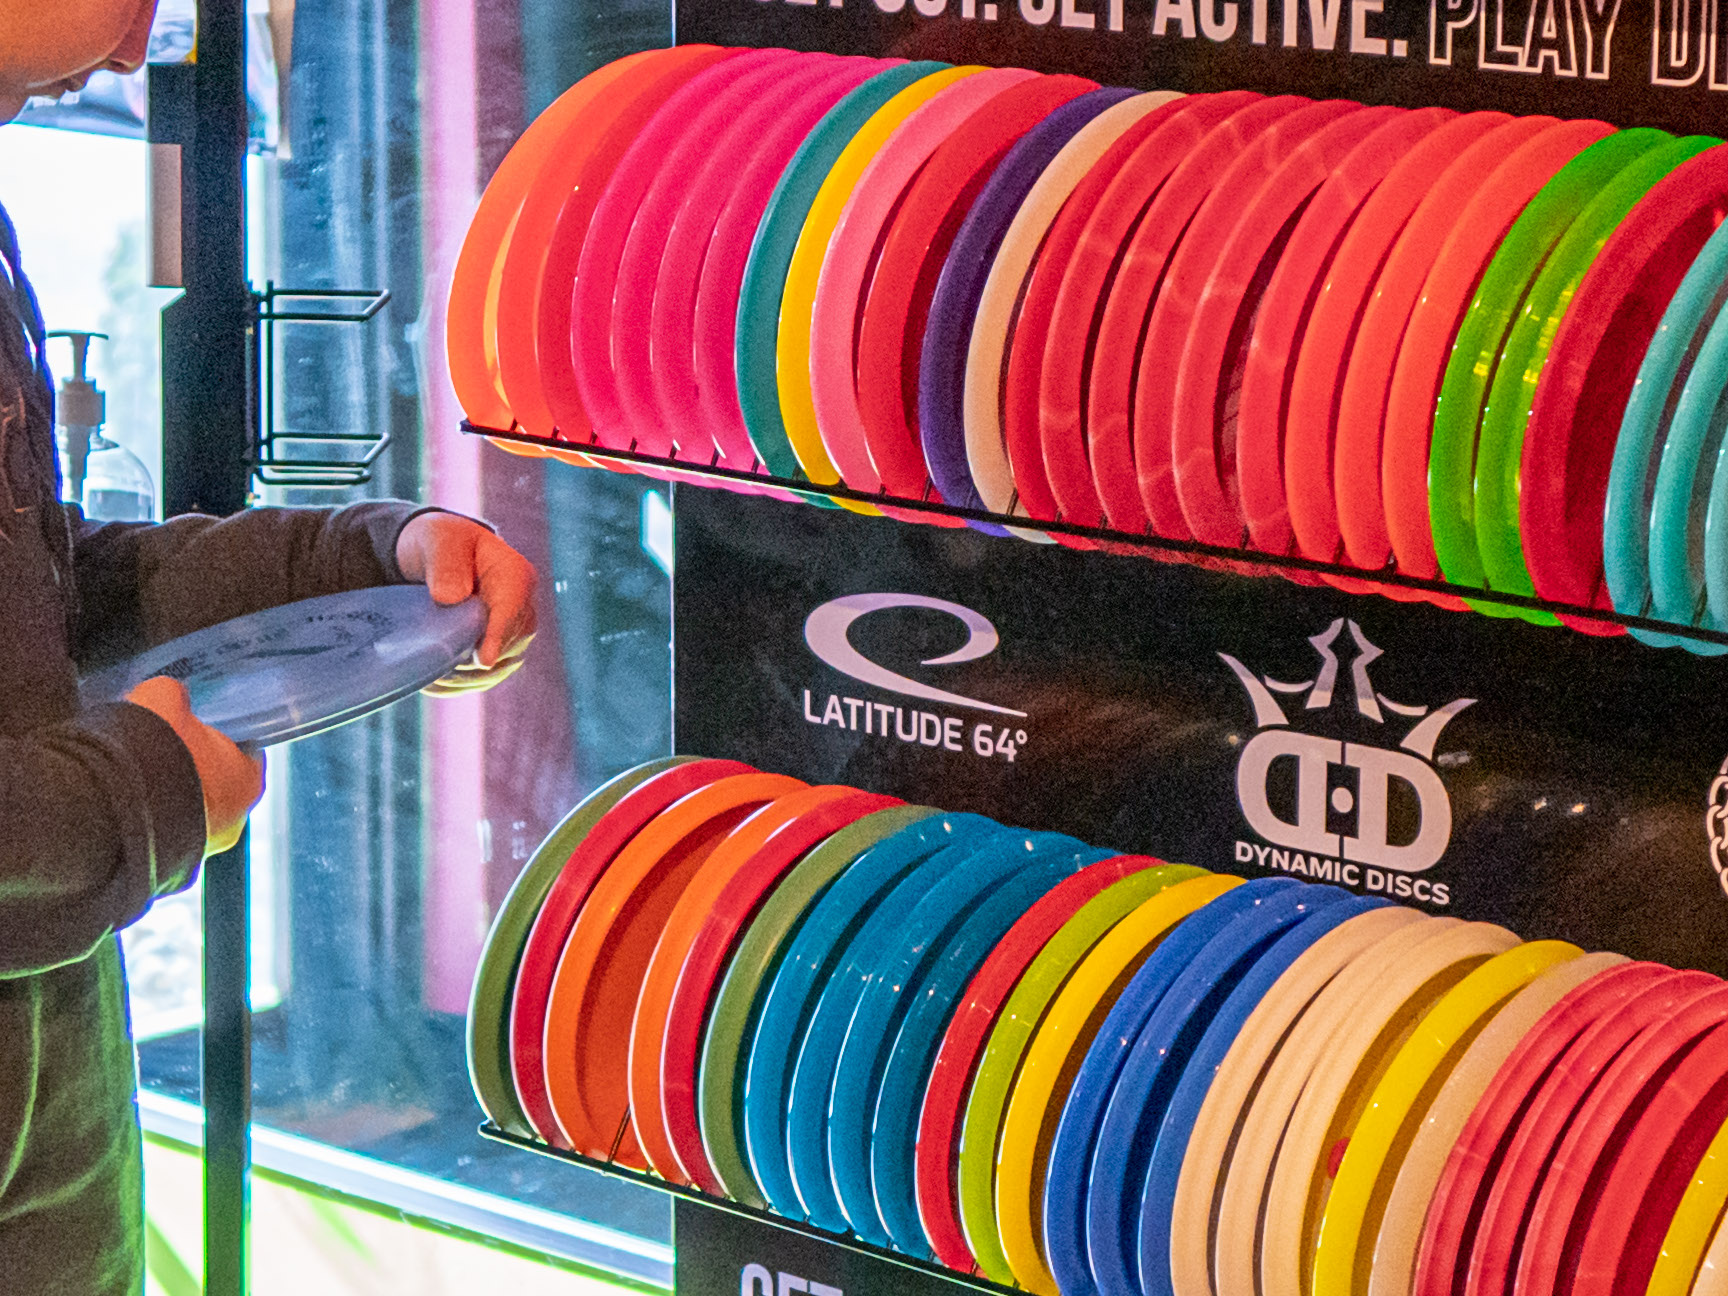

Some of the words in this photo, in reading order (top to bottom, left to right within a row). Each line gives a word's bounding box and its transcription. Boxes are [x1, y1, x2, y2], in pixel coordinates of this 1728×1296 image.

[803, 688, 963, 753] LATITUDE
[1234, 840, 1360, 887] DYNAMIC
[1365, 867, 1451, 906] DISCS
